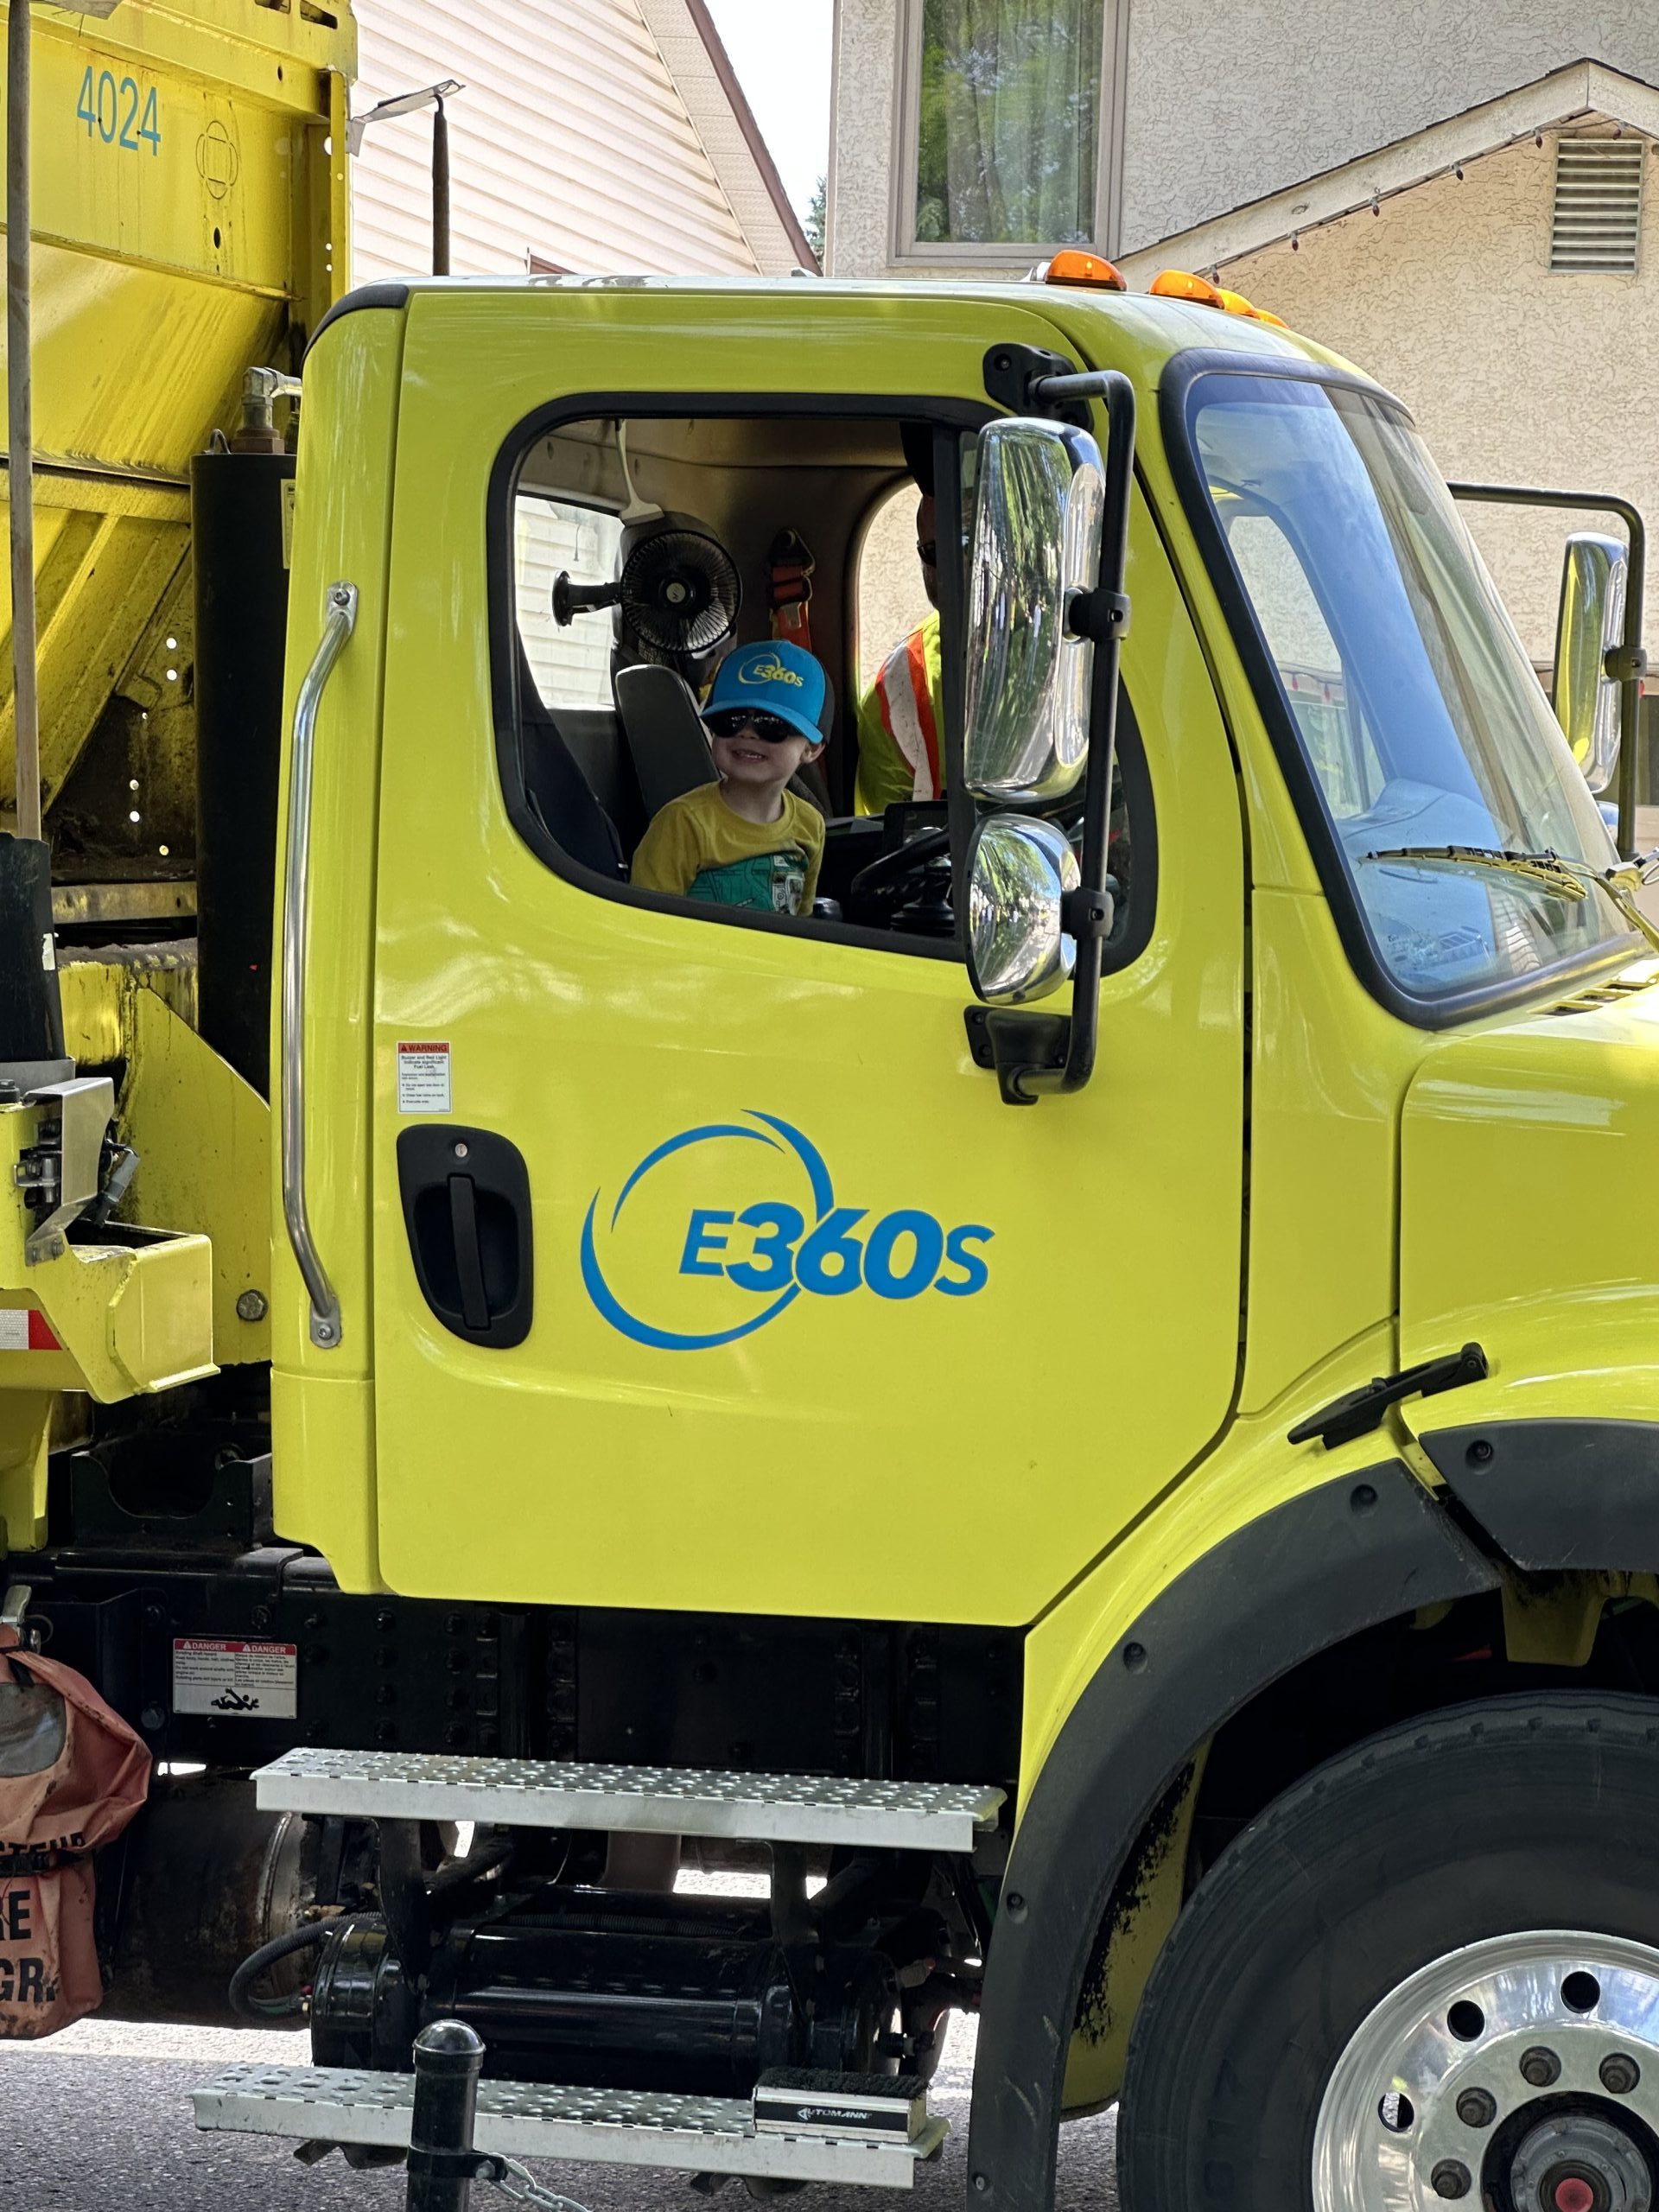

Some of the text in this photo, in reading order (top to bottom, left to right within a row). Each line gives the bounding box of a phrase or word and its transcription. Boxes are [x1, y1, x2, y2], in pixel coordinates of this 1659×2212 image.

[77, 65, 161, 156] 4024
[753, 664, 804, 687] E360S
[678, 1202, 995, 1300] E360S
[193, 1643, 226, 1651] DANGER
[252, 1644, 286, 1654] DANGER
[0, 1890, 31, 1941] E
[798, 2107, 868, 2120] AUTOMANN
